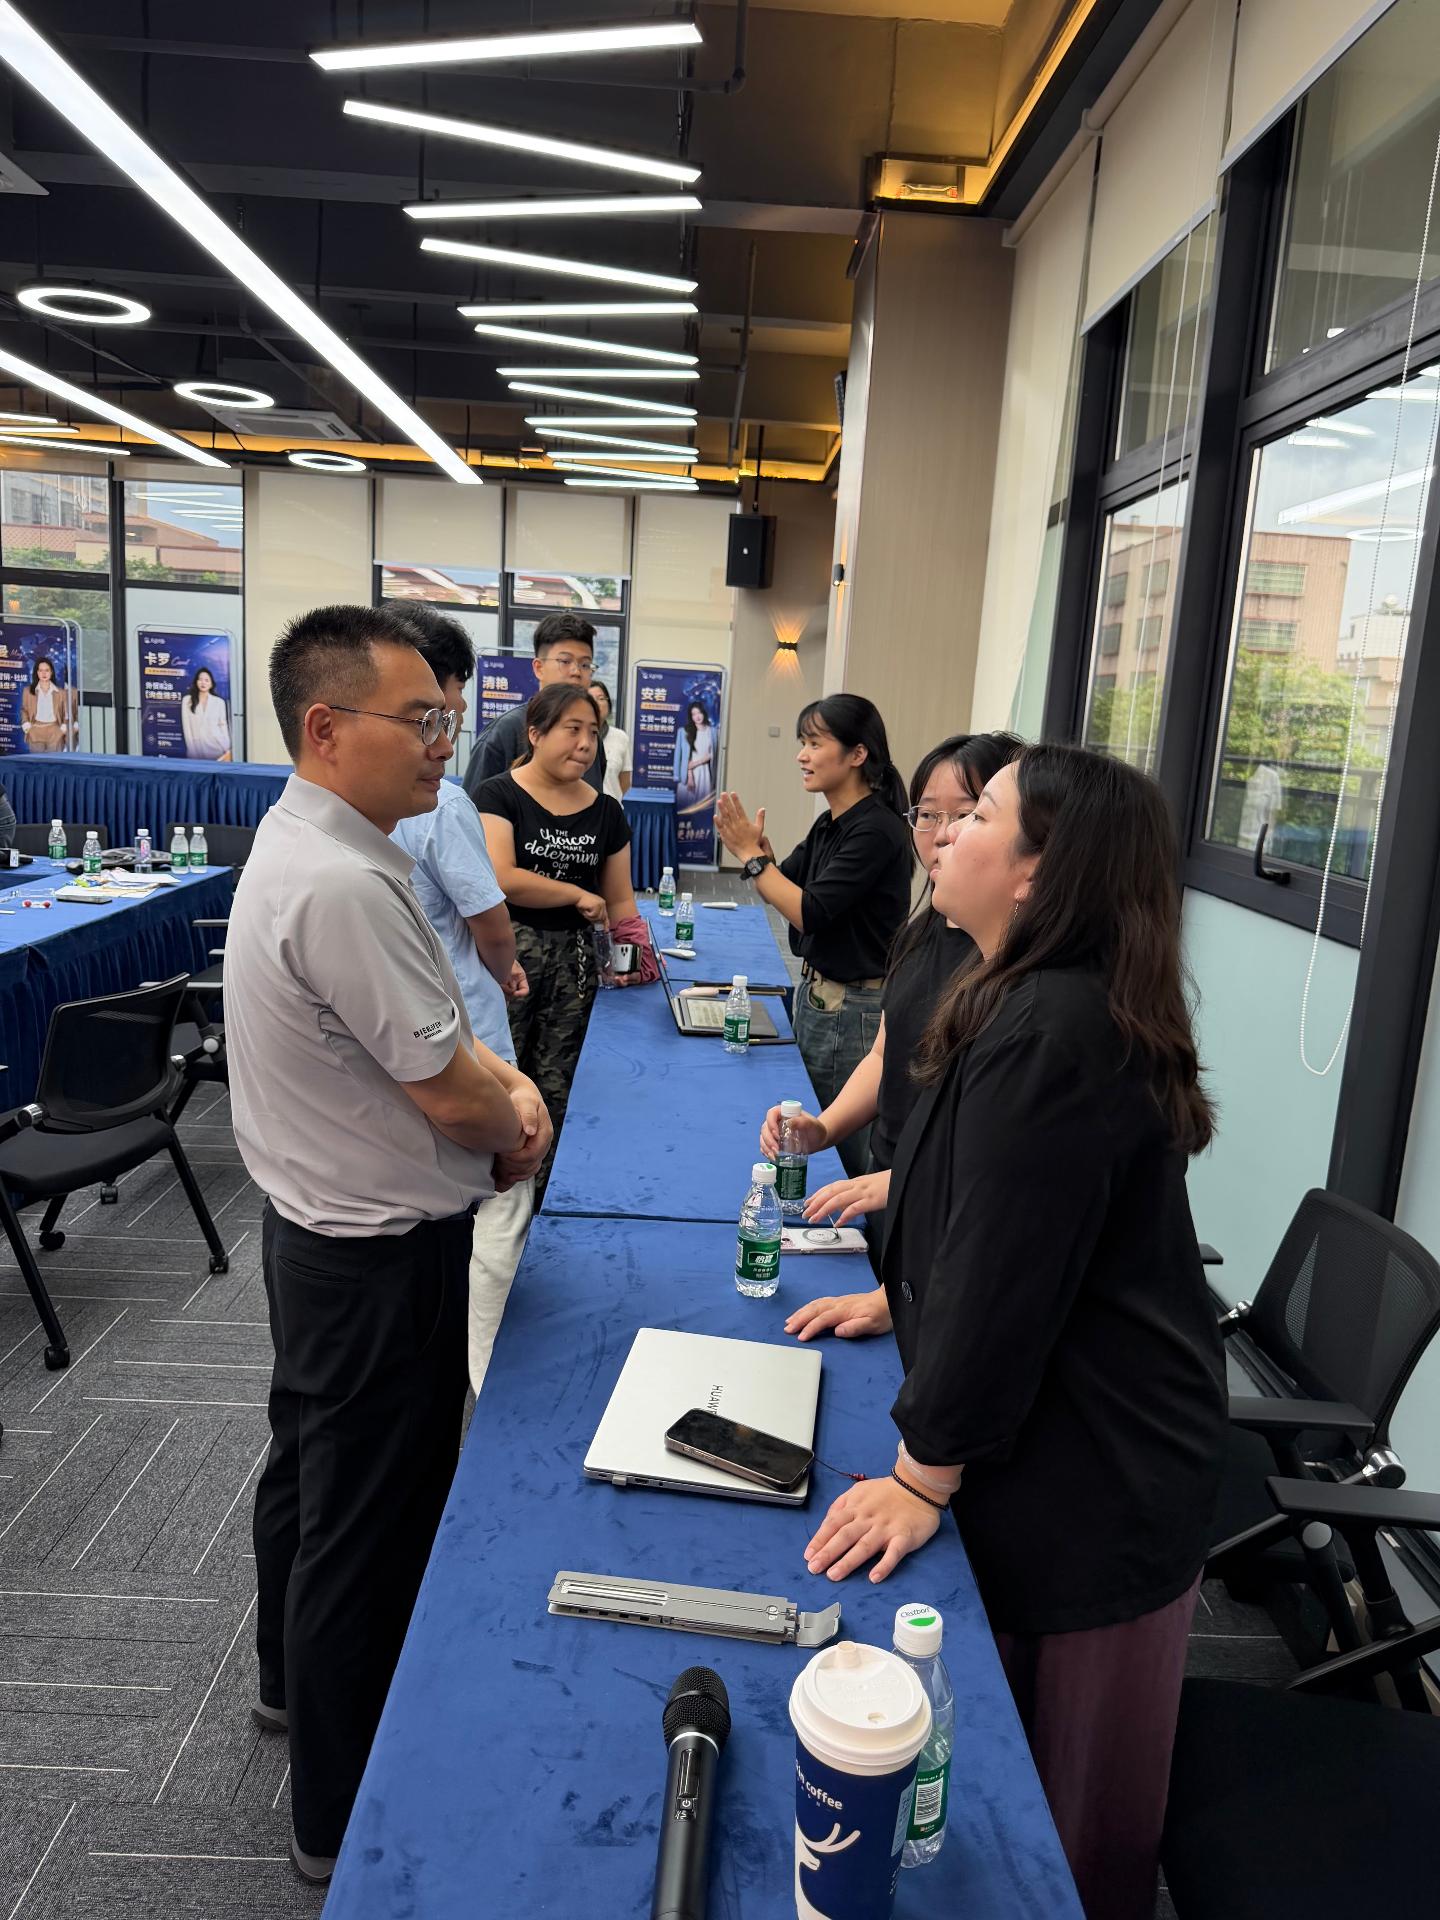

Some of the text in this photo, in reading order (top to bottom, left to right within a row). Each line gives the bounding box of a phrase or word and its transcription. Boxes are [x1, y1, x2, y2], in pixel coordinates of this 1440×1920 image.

[555, 829, 569, 837] THE
[552, 861, 570, 870] OUR
[805, 1781, 843, 1810] coffee
